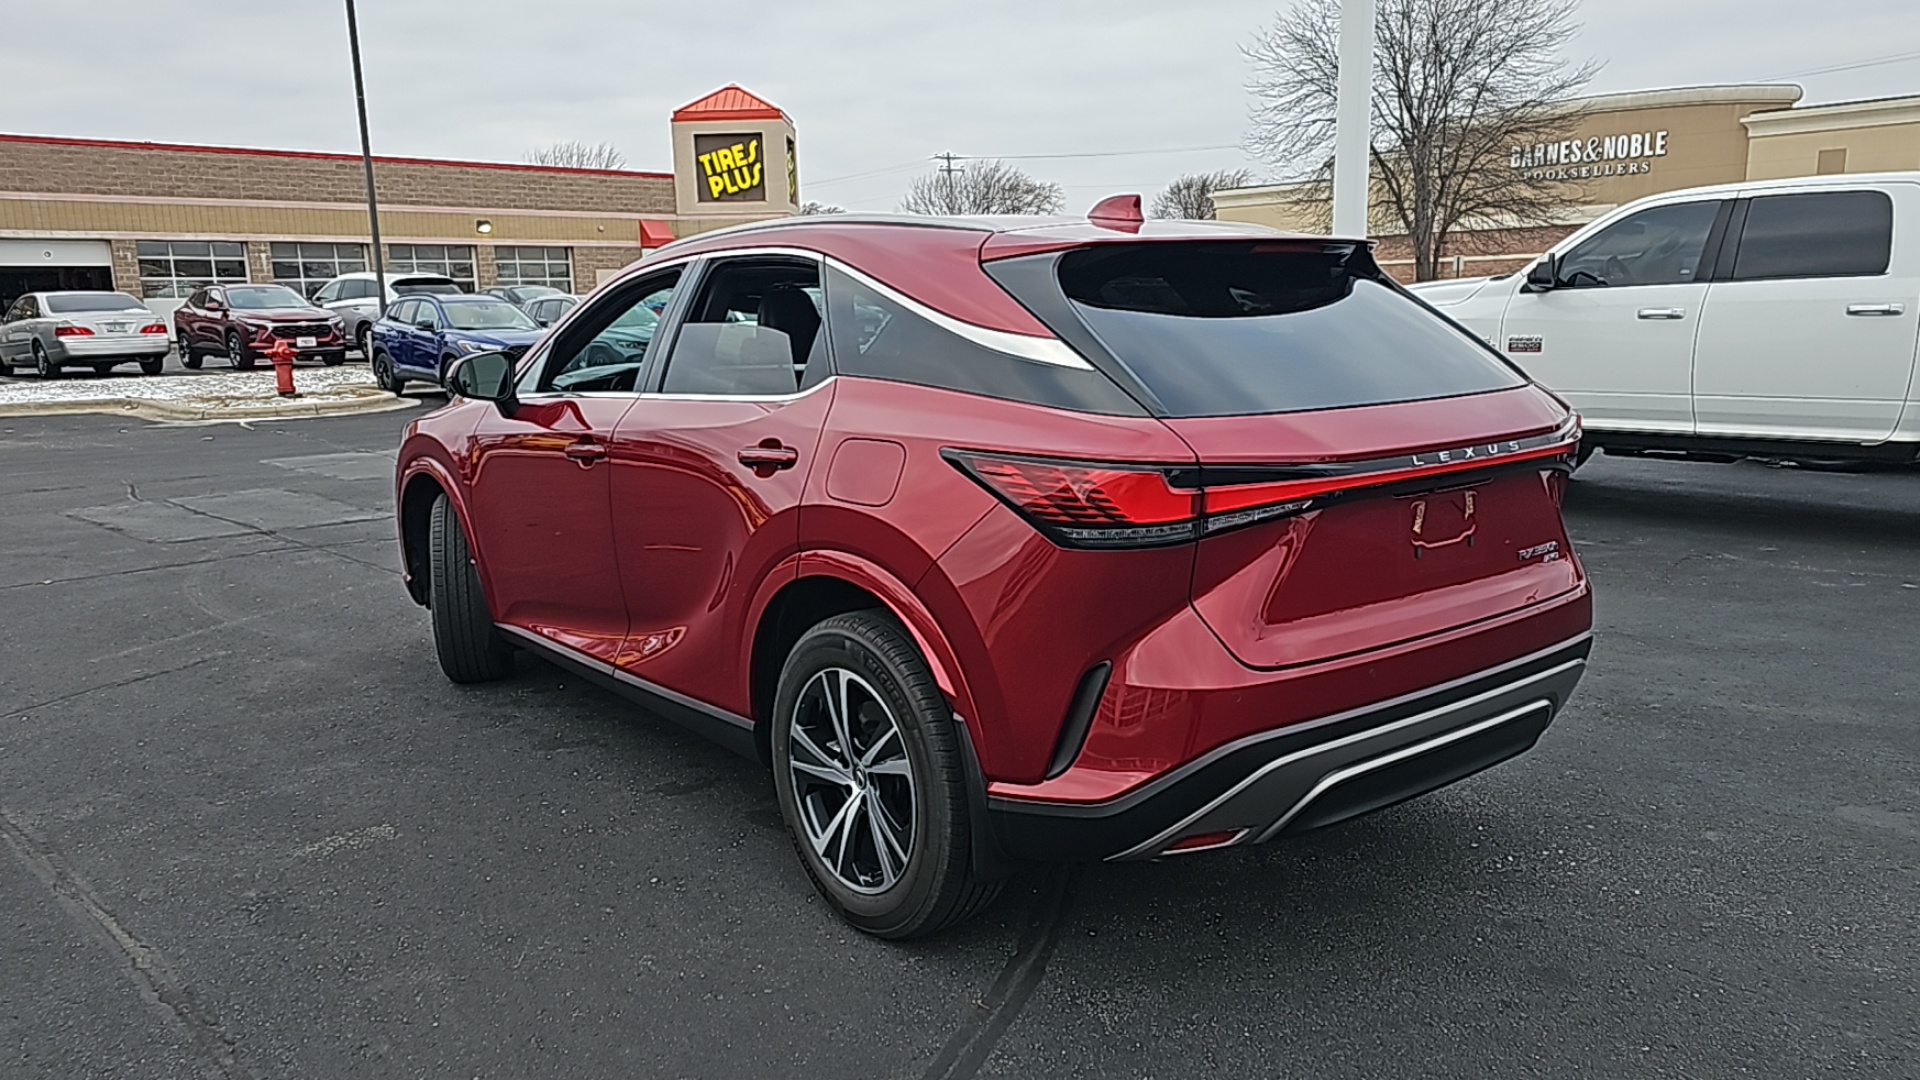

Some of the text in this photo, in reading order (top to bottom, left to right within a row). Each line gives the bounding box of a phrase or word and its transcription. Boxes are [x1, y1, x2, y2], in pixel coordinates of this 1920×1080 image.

[698, 139, 758, 176] TIRES
[1523, 161, 1650, 181] BOOKSELLERS
[708, 162, 762, 198] PLUS
[1413, 441, 1520, 465] LEXUS
